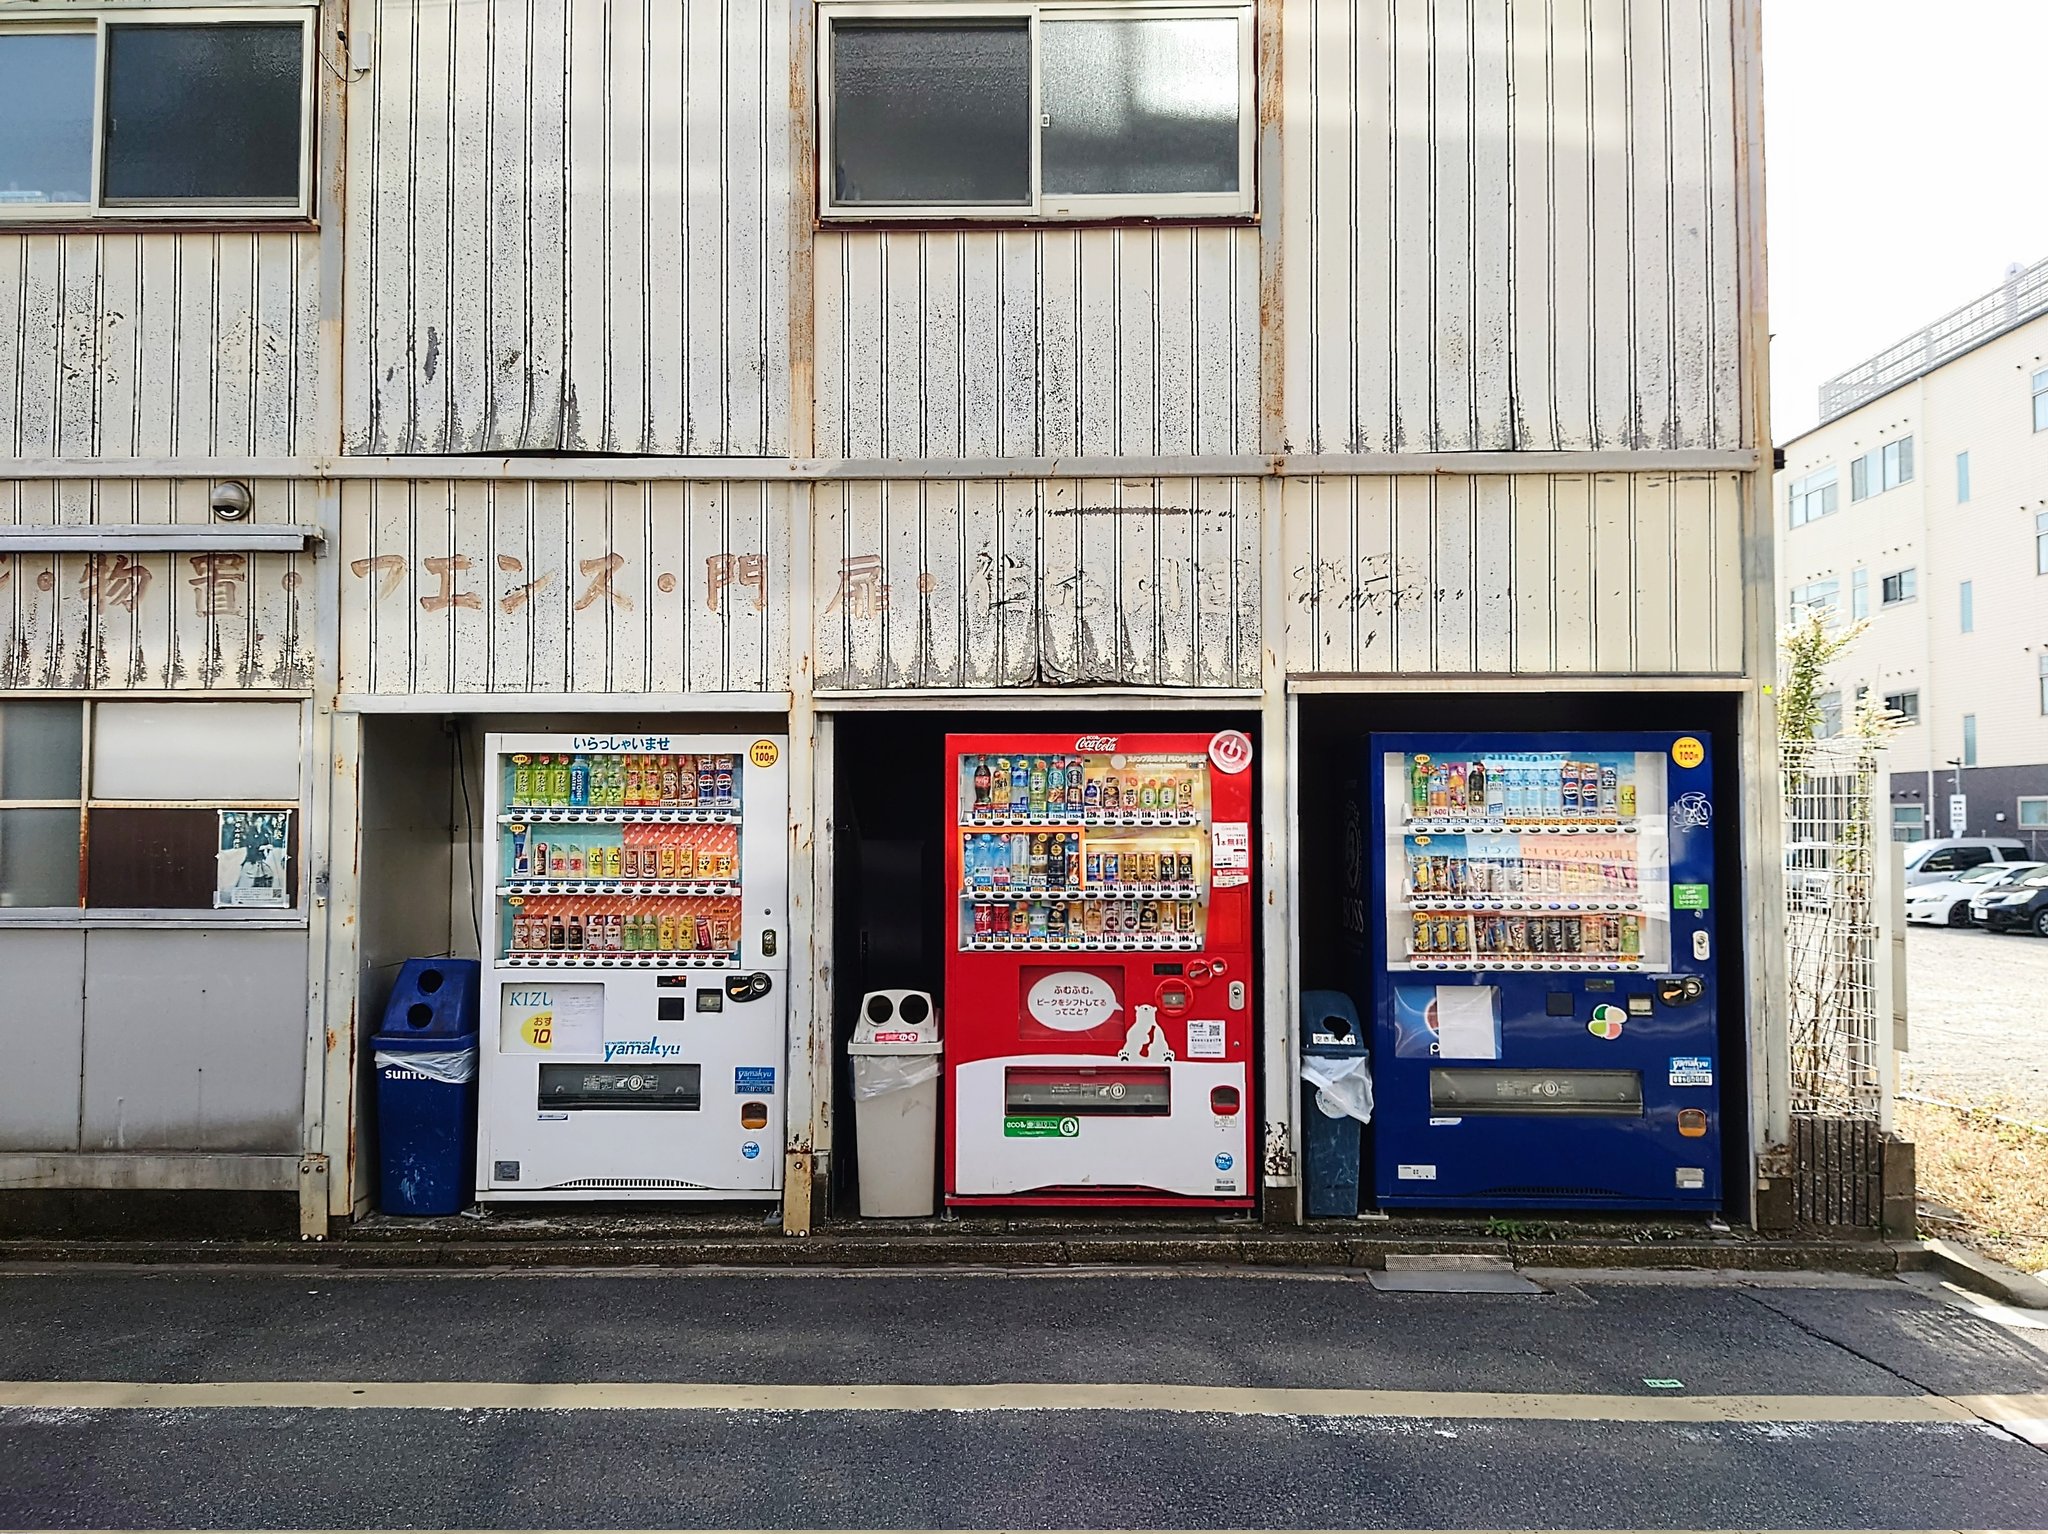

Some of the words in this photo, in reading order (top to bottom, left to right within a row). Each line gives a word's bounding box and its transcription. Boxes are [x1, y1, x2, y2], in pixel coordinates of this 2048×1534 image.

[573, 736, 670, 751] いらっしゃいませ
[1075, 736, 1118, 751] Coca-Cola
[1054, 985, 1094, 995] ふむふむ。
[1037, 998, 1106, 1007] ピークをシフトしてる
[1054, 1008, 1089, 1016] ってこと?
[533, 1028, 553, 1044] 10
[604, 1035, 681, 1062] yamakyu
[738, 1069, 772, 1080] yamakyu
